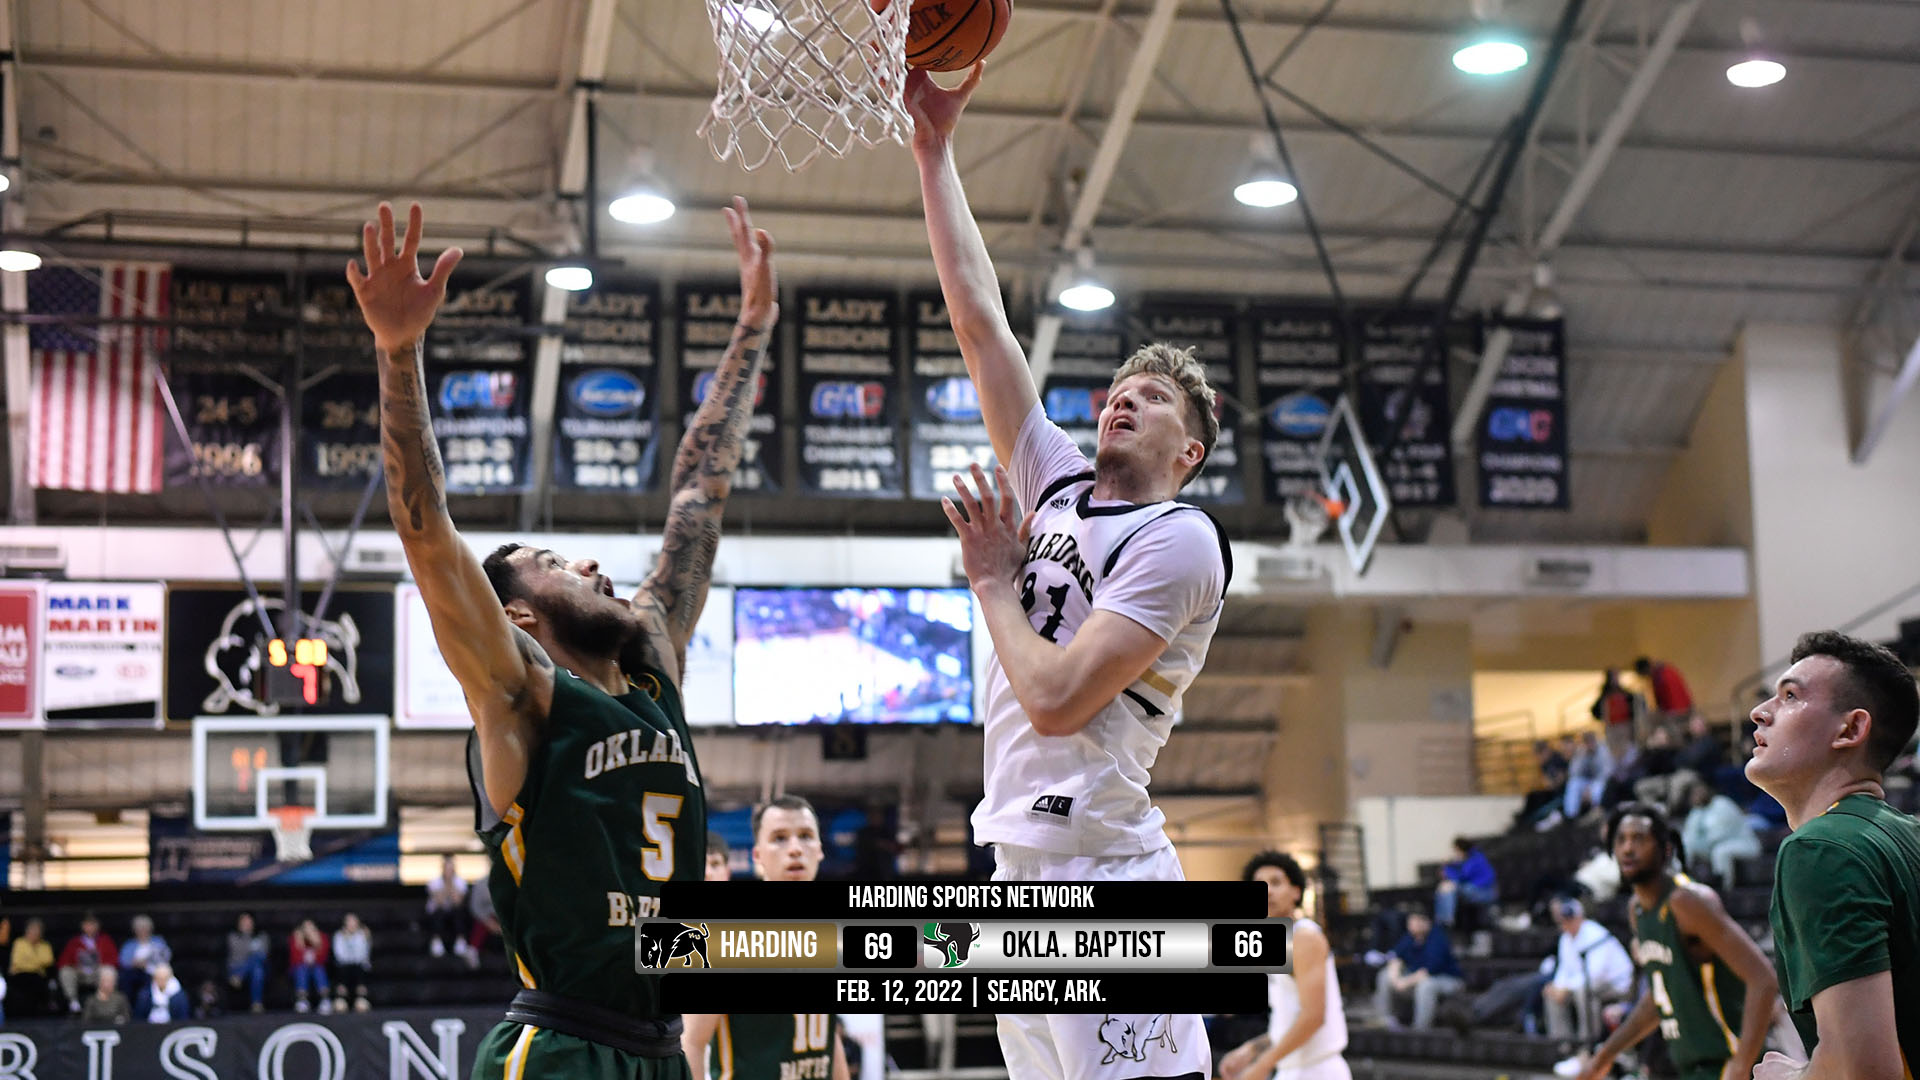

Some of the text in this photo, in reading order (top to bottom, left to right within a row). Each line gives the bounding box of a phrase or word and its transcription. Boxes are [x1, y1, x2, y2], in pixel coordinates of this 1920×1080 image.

[50, 597, 130, 610] MARK
[49, 619, 158, 632] MARTIN
[641, 791, 685, 882] 5
